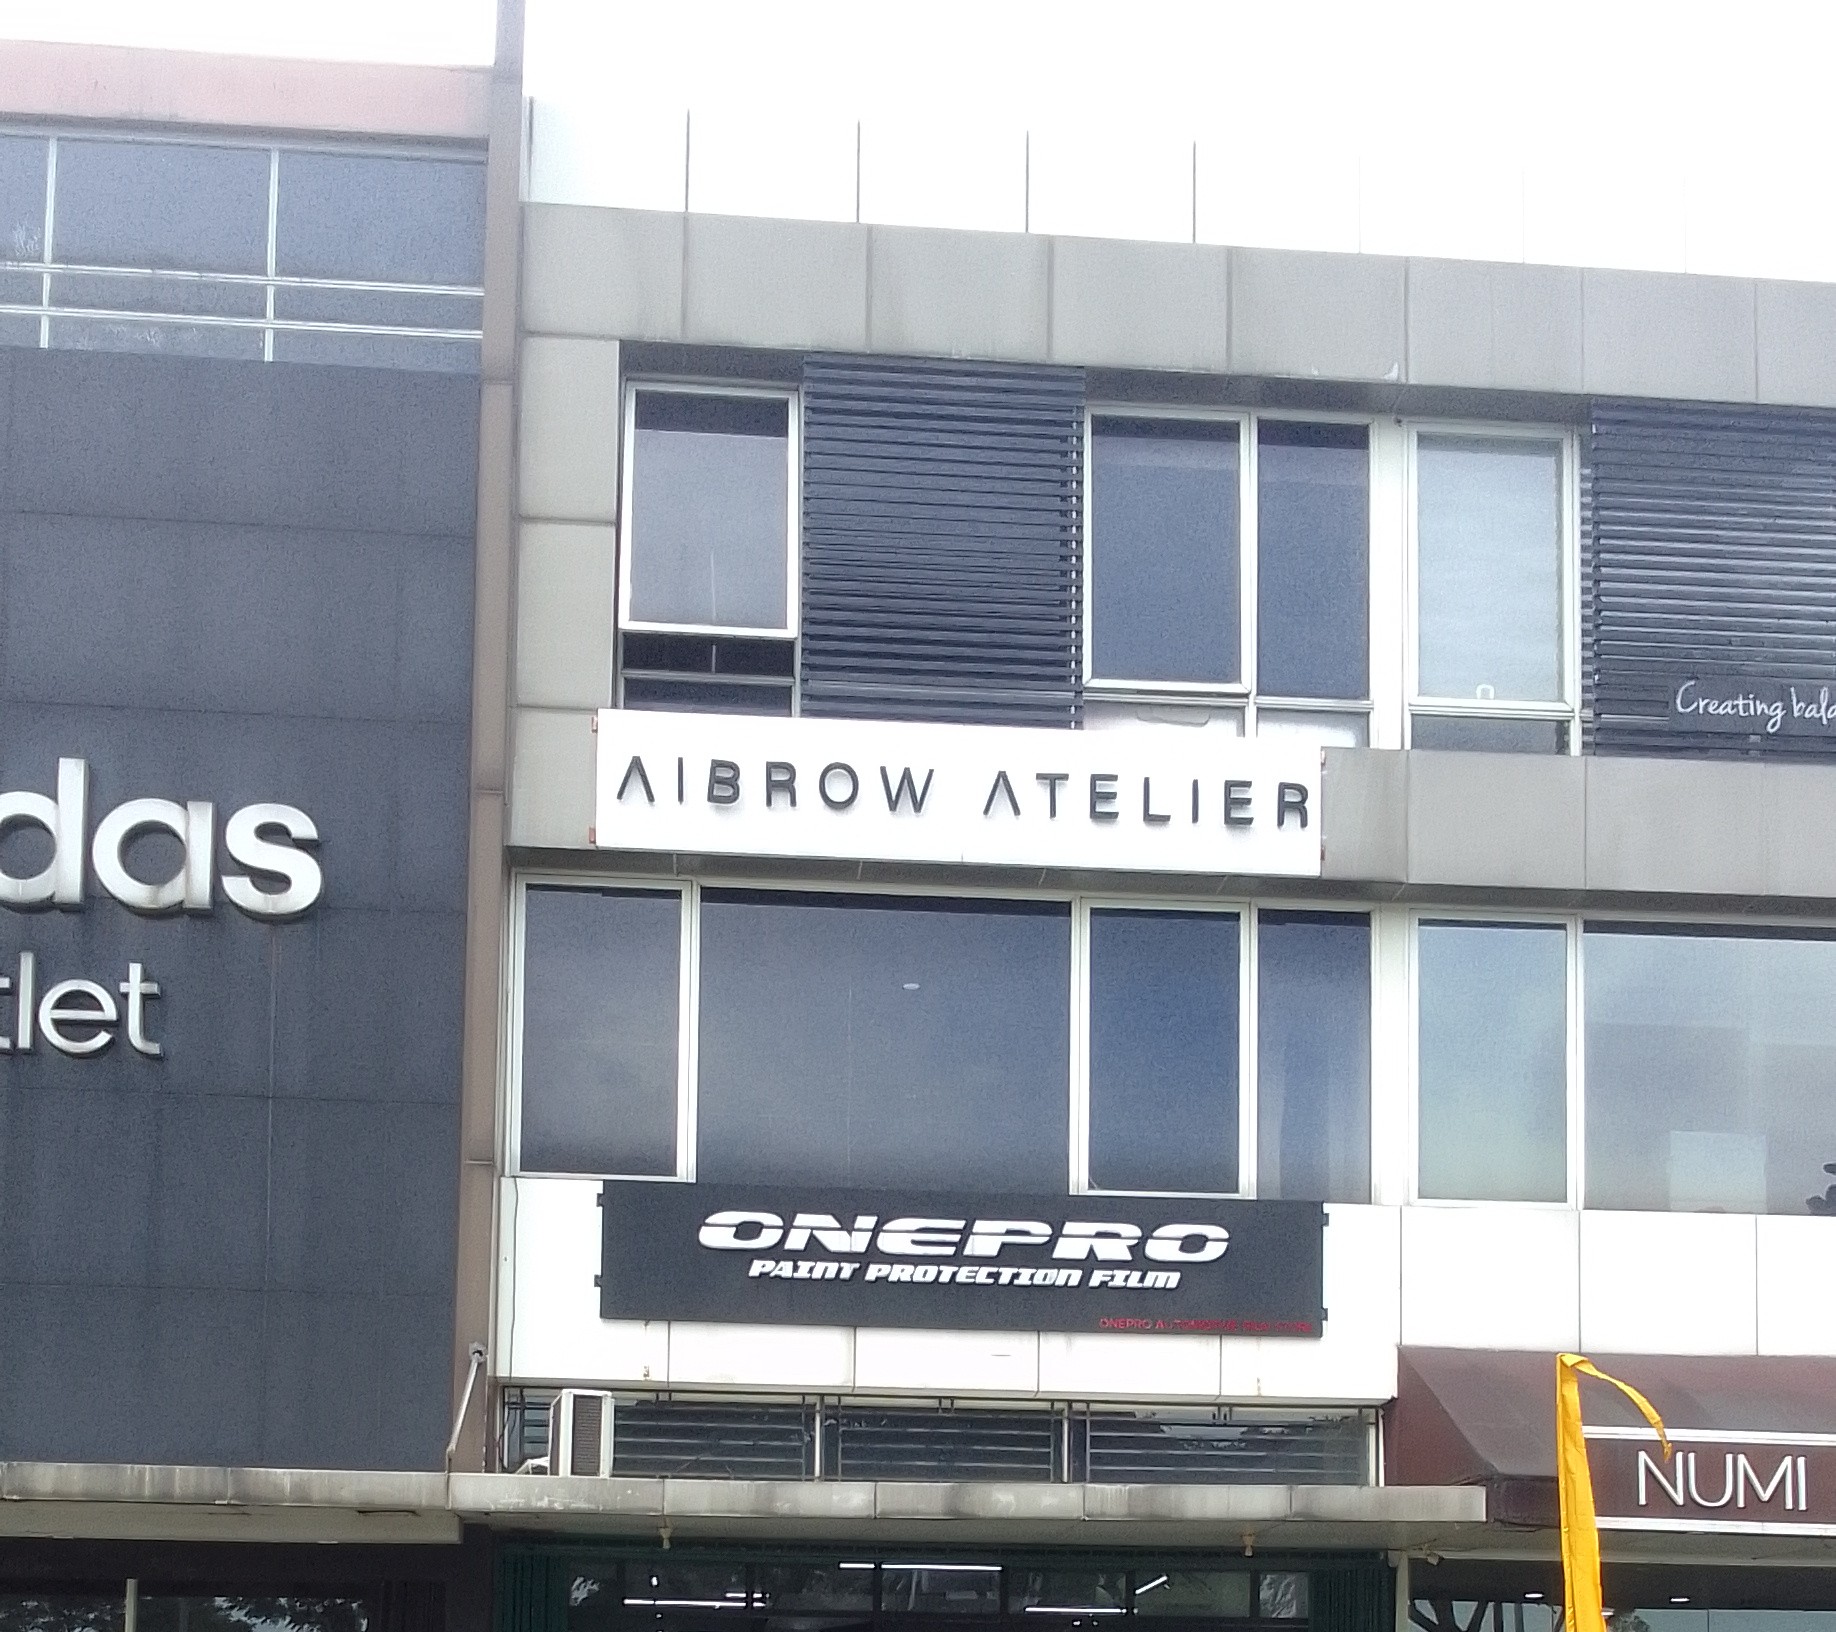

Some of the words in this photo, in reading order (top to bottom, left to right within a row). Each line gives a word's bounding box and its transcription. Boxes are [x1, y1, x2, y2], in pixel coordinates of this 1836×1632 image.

[1676, 680, 1787, 733] Creating
[616, 755, 934, 813] AIBROW
[983, 770, 1309, 829] ATELIER
[698, 1210, 1230, 1263] ONEPRO
[748, 1259, 861, 1280] PAINT
[864, 1264, 1084, 1287] PROTECTION
[1087, 1270, 1182, 1289] FILM
[1099, 1318, 1152, 1330] ONEPRO
[1638, 1450, 1808, 1511] NUMI
